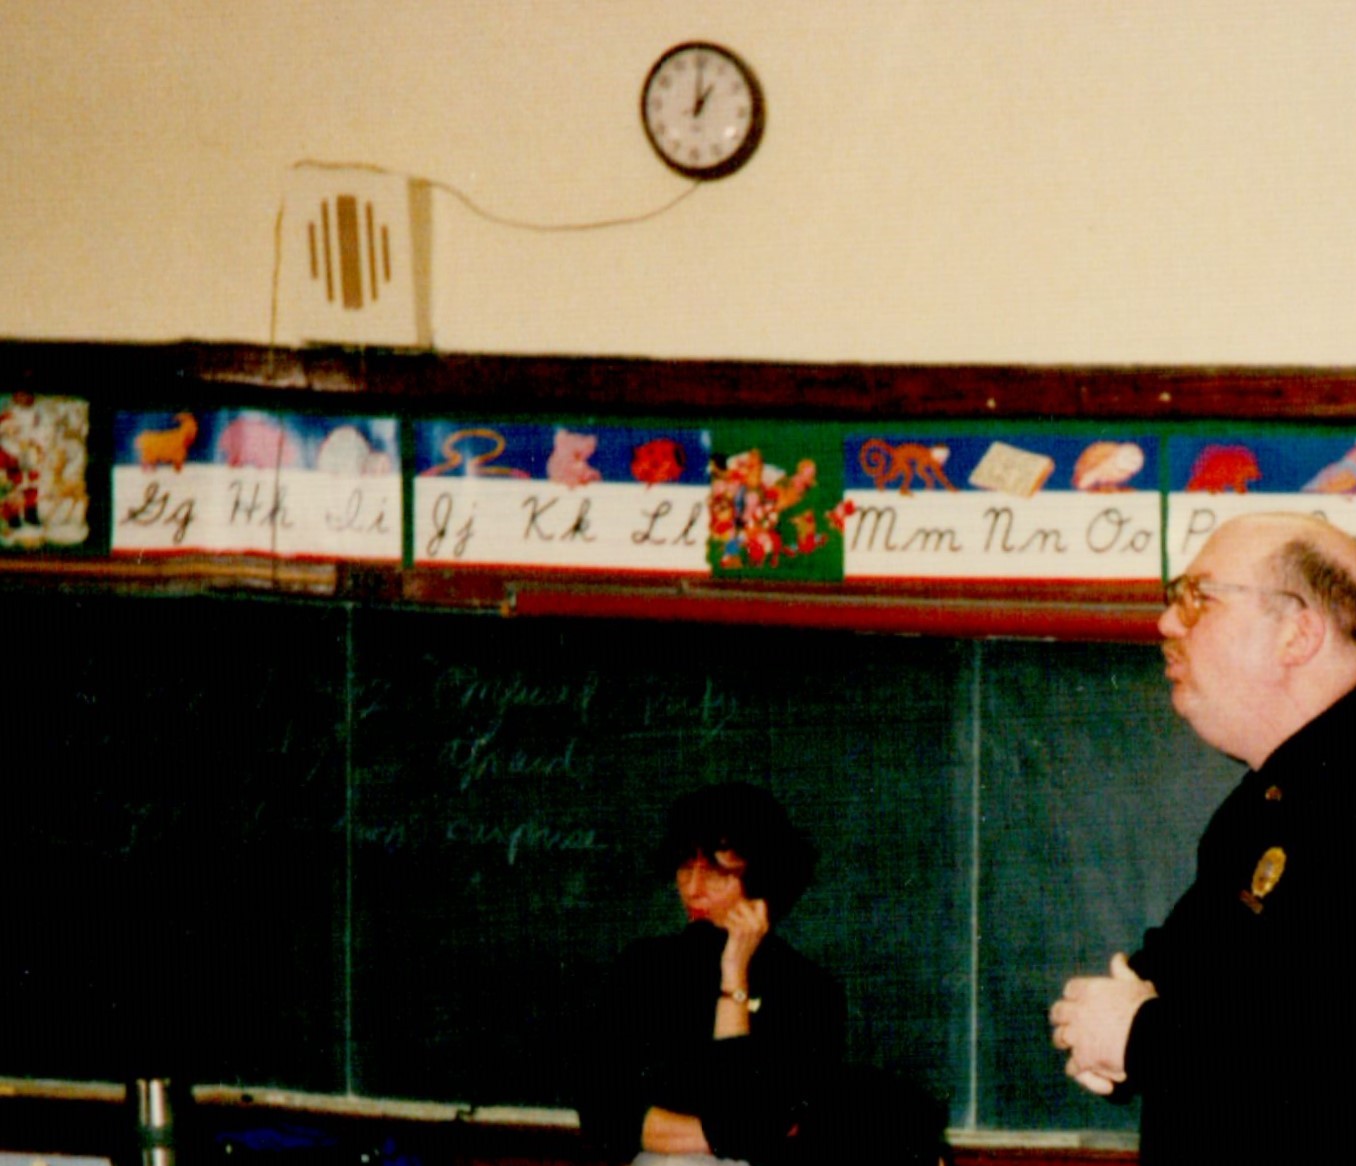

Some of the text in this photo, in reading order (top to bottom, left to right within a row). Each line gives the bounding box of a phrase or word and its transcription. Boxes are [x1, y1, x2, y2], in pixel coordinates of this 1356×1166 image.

[426, 491, 706, 558] Jj Kk Ll
[850, 504, 1154, 554] Mm Nn Oo
[1181, 508, 1217, 556] P
